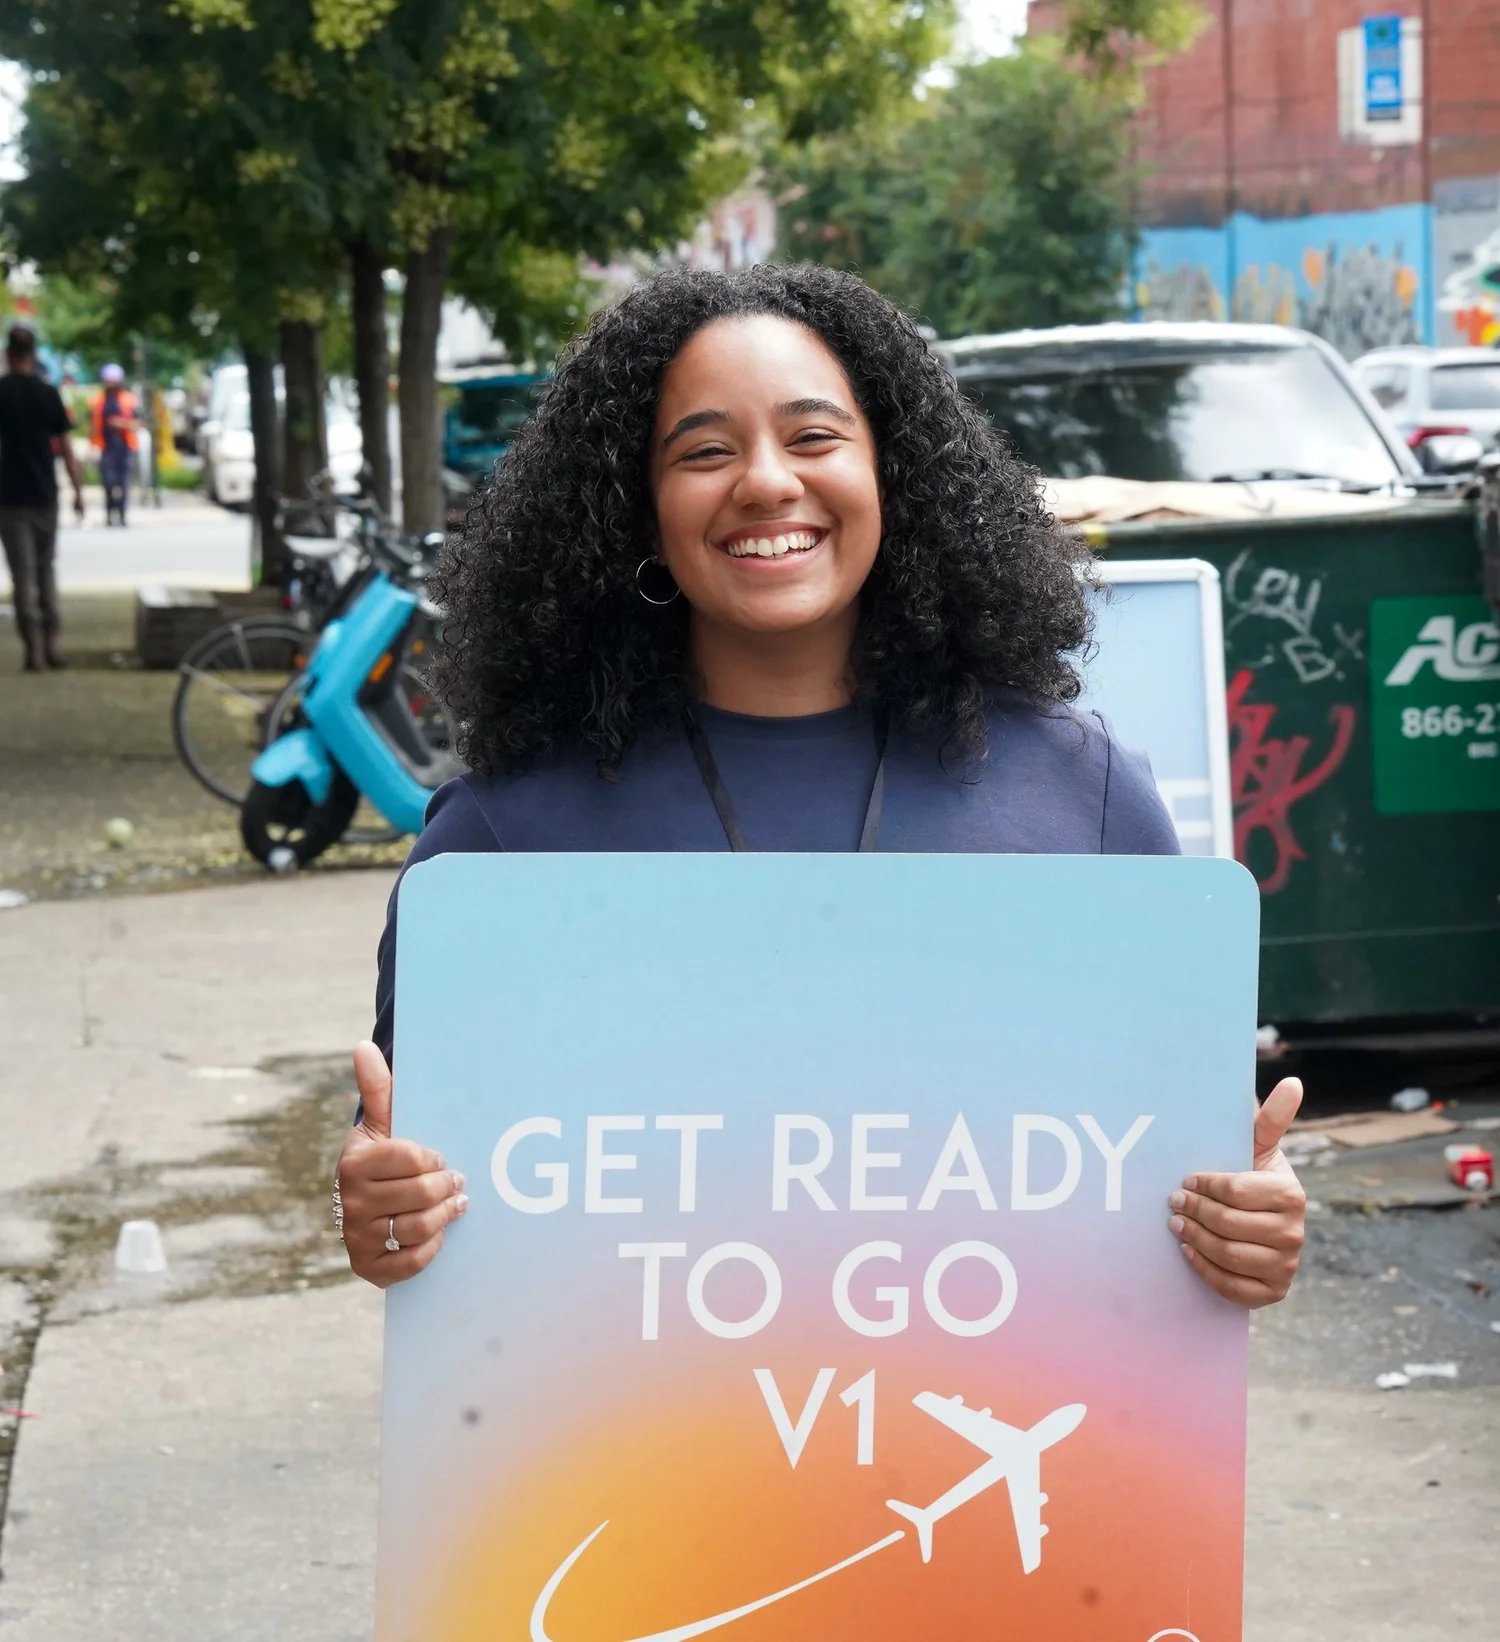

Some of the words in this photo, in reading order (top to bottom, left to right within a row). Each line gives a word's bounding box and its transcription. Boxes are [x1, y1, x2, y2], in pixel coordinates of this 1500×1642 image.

[1401, 703, 1500, 738] 866-2
[491, 1115, 724, 1214] GET
[772, 1111, 1154, 1212] READY
[619, 1241, 783, 1342] TO
[832, 1240, 1019, 1338] GO
[753, 1368, 876, 1469] V1
